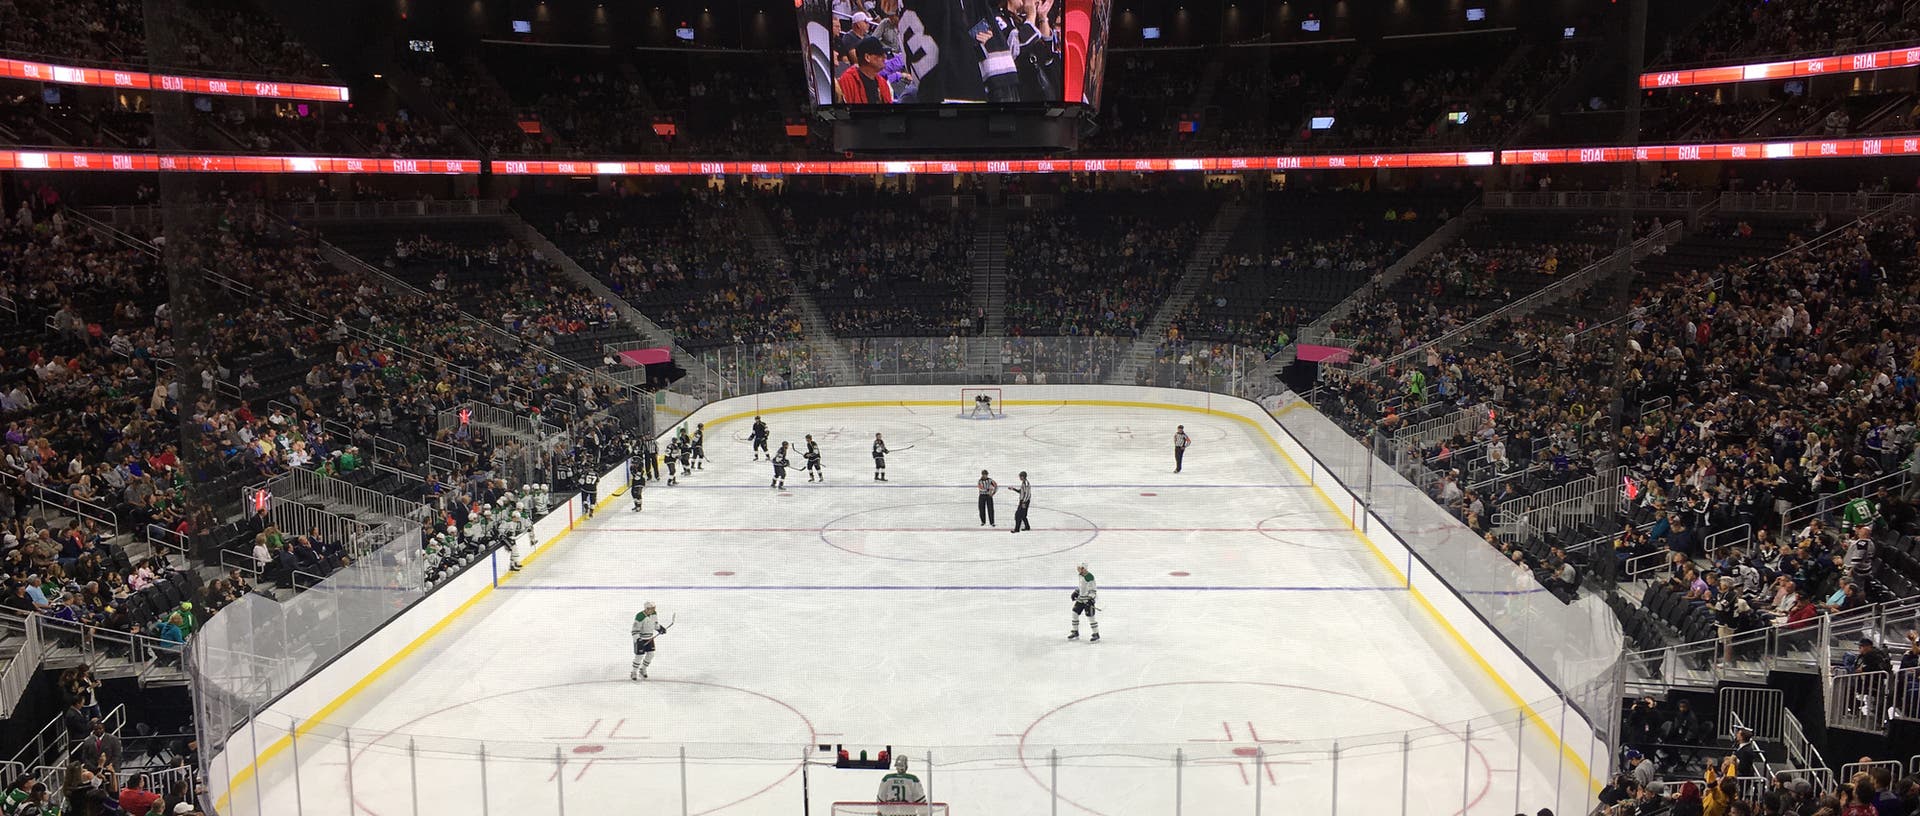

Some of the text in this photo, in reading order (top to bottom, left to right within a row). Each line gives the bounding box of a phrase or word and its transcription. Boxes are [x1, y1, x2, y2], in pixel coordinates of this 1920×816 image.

[1853, 54, 1877, 69] GOAL
[24, 64, 40, 78] GOAL
[114, 73, 133, 86] GOAL
[162, 76, 185, 91] GOAL
[209, 81, 229, 93] GOAL
[1533, 151, 1549, 162] GOAL
[1580, 149, 1605, 162] GOAL
[1678, 146, 1700, 160] GOAL
[1731, 146, 1747, 157] GOAL
[1821, 143, 1838, 155] GOAL
[1862, 140, 1883, 155] GOAL
[1904, 140, 1918, 152] GOAL
[74, 155, 463, 172] GOAL GOAL GOAL GOAL GOAL GOAL
[506, 157, 1346, 173] GOAL GOAL GOAL GOAL GOAL GOAL GOAL GOAL GOAL GOAL GOAL GOAL GOAL
[557, 470, 566, 480] 10
[585, 475, 597, 485] 67
[1856, 505, 1871, 520] 91
[891, 785, 906, 802] 31
